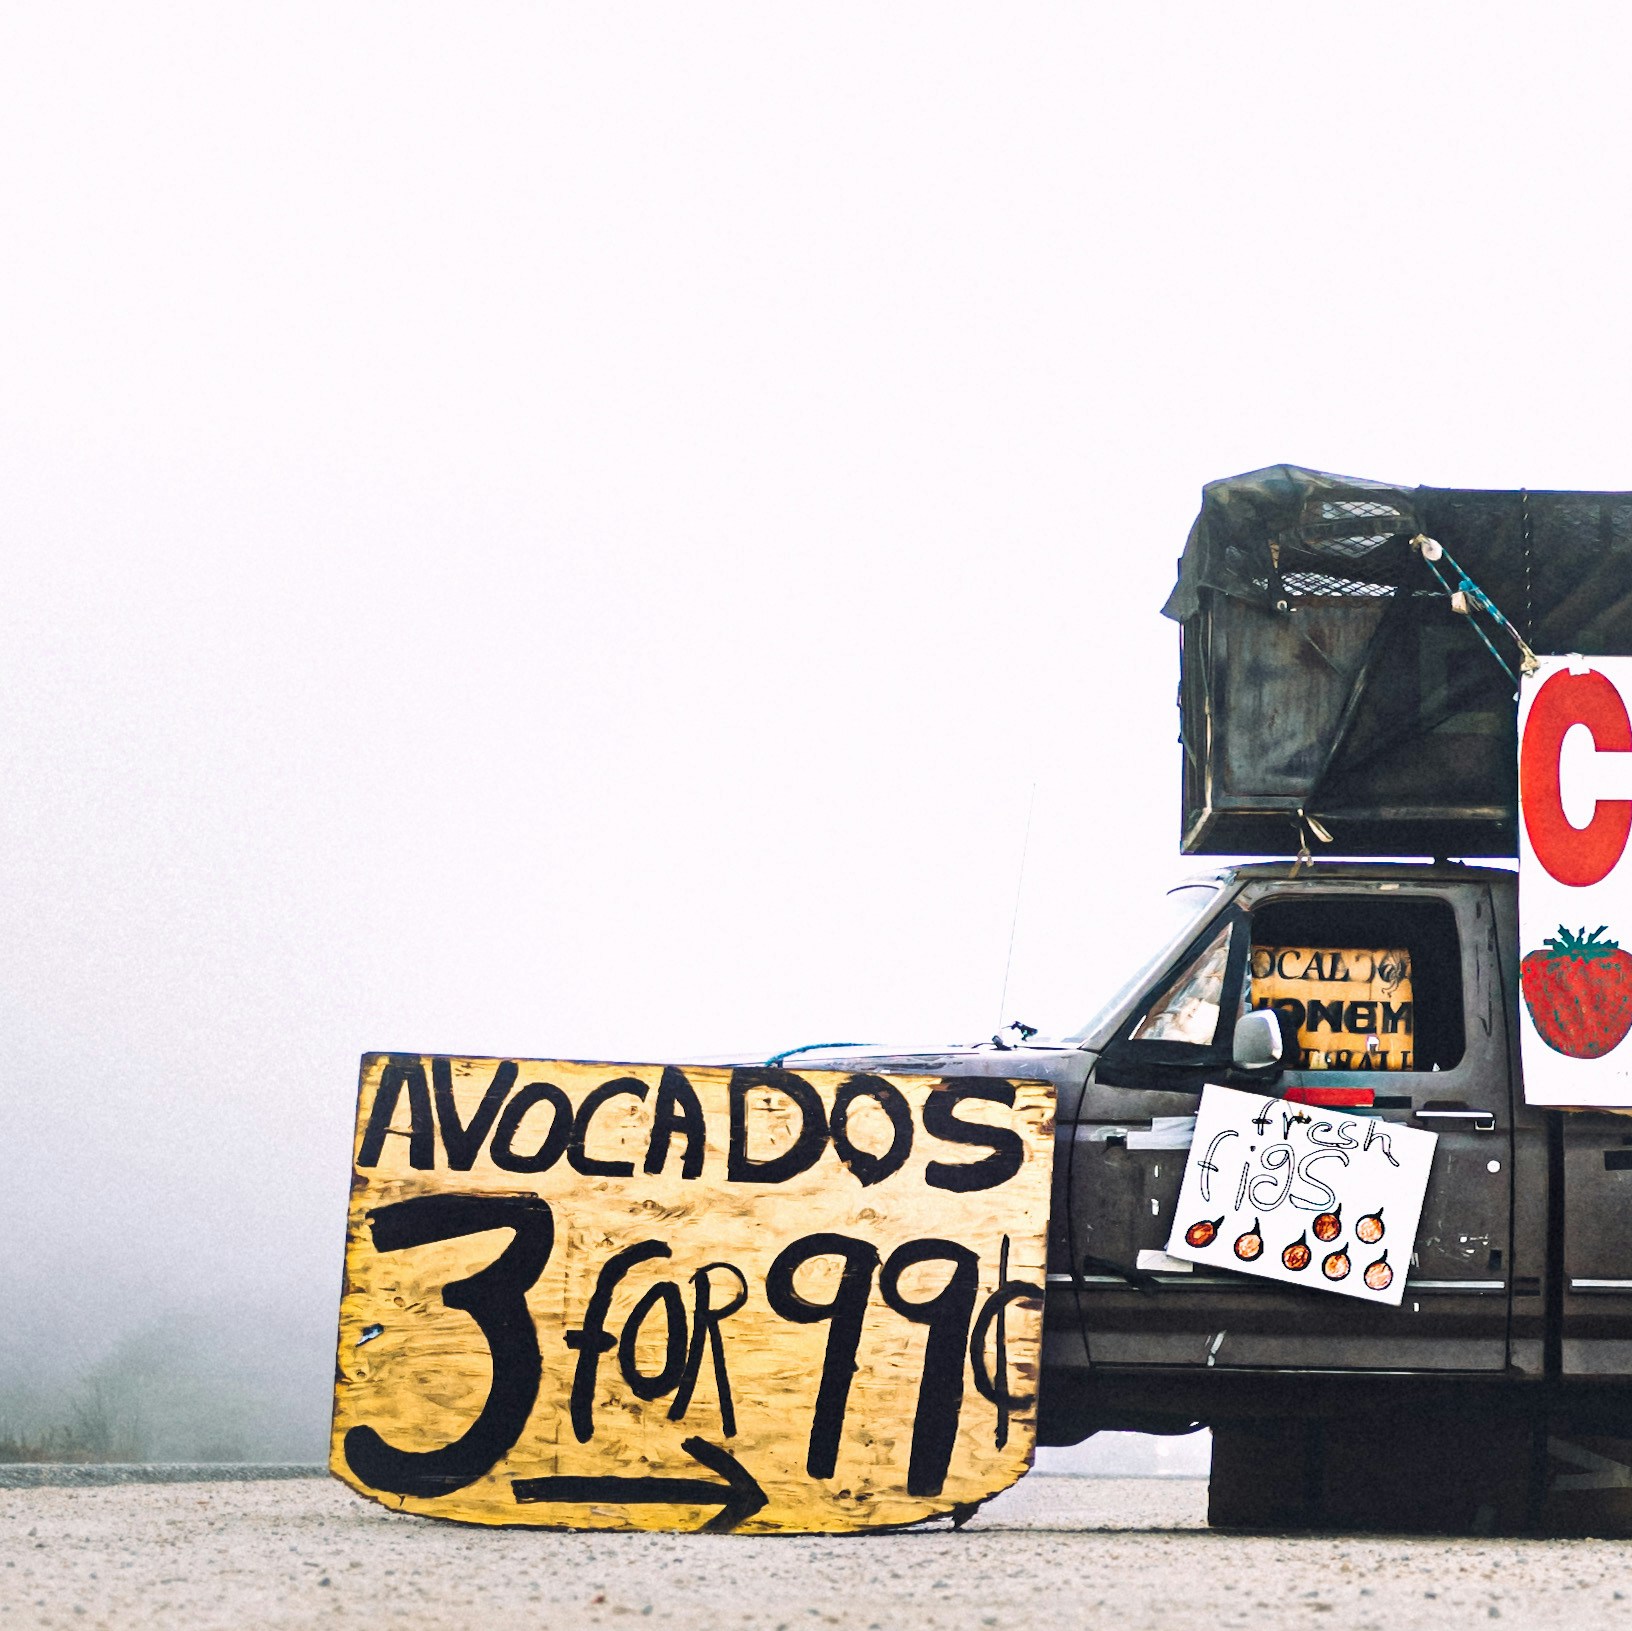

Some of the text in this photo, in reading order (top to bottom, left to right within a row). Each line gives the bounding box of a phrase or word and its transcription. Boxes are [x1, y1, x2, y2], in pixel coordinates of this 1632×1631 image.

[356, 1056, 1024, 1193] AVOCADOS
[1252, 1099, 1399, 1167] fresh
[344, 1192, 554, 1499] 3
[766, 1233, 1045, 1497] 99¢
